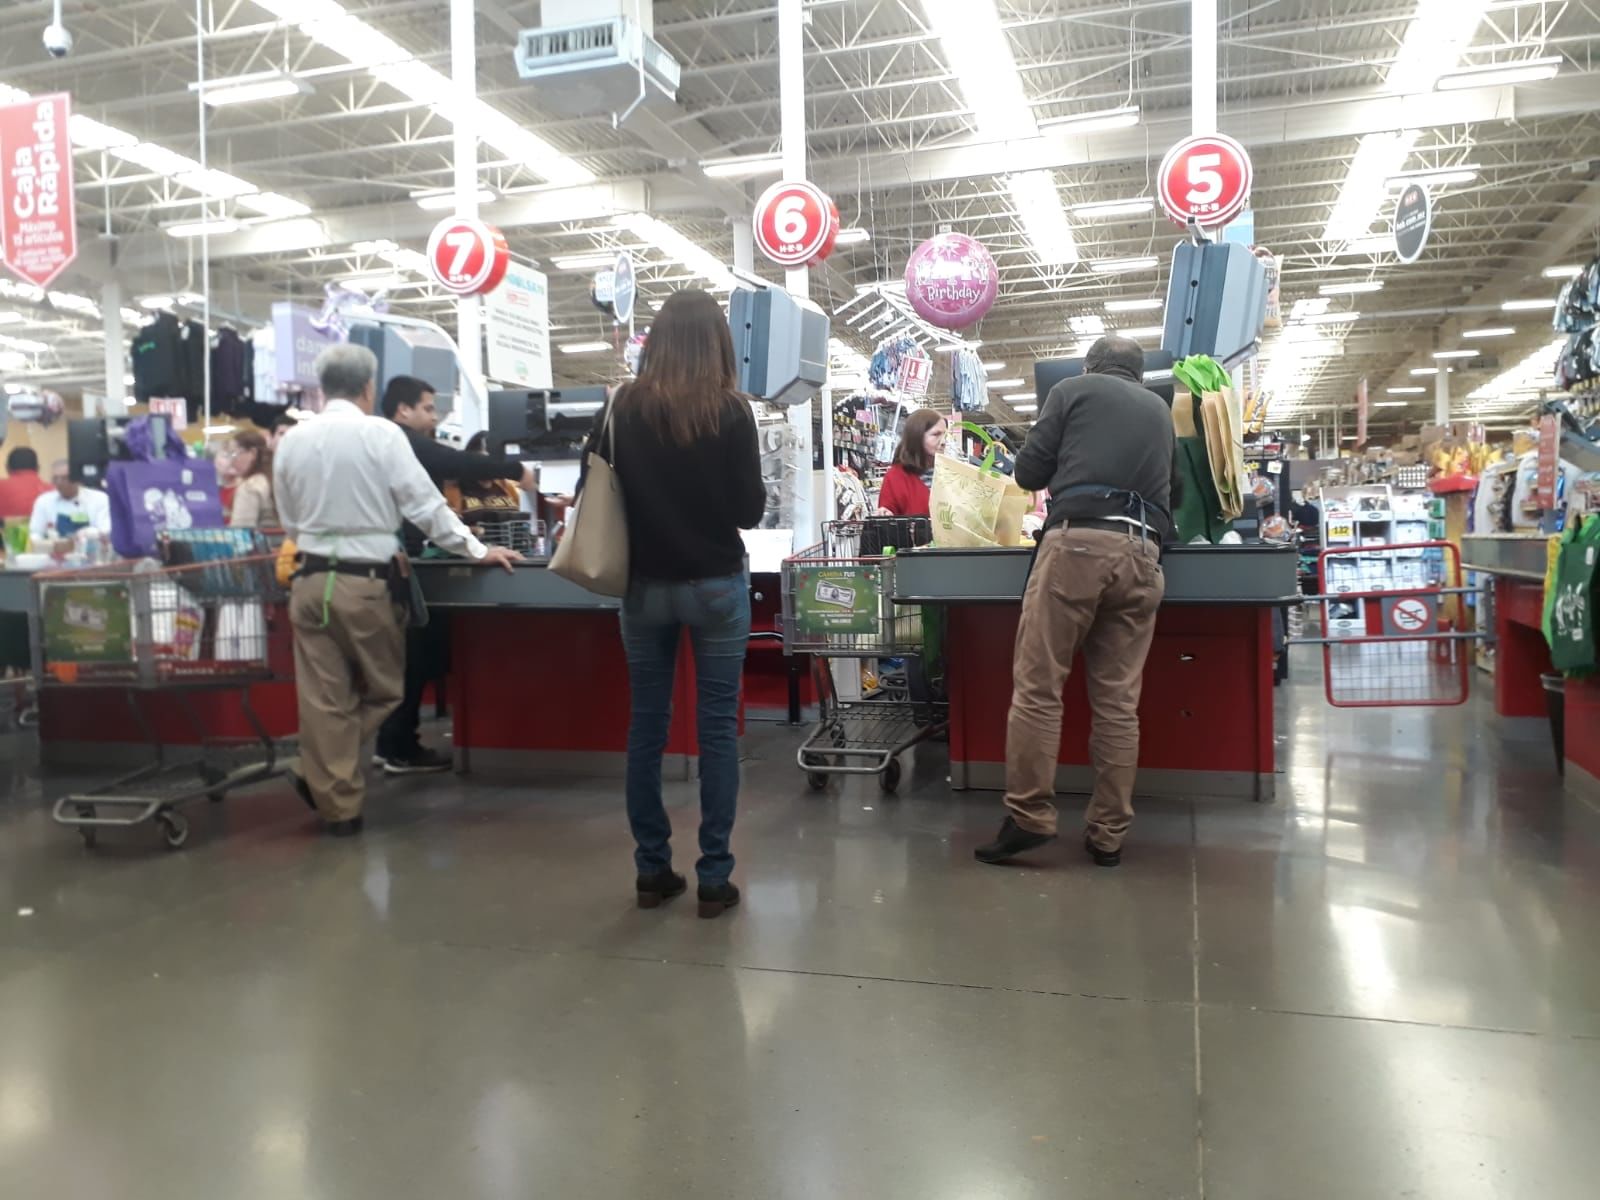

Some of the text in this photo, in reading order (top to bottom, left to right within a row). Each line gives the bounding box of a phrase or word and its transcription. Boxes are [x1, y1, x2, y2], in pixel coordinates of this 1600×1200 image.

[12, 147, 37, 218] Caja
[33, 101, 60, 215] Rápida
[1185, 152, 1223, 205] 5
[774, 195, 808, 244] 6
[446, 231, 476, 276] 7
[927, 283, 981, 305] Birthday
